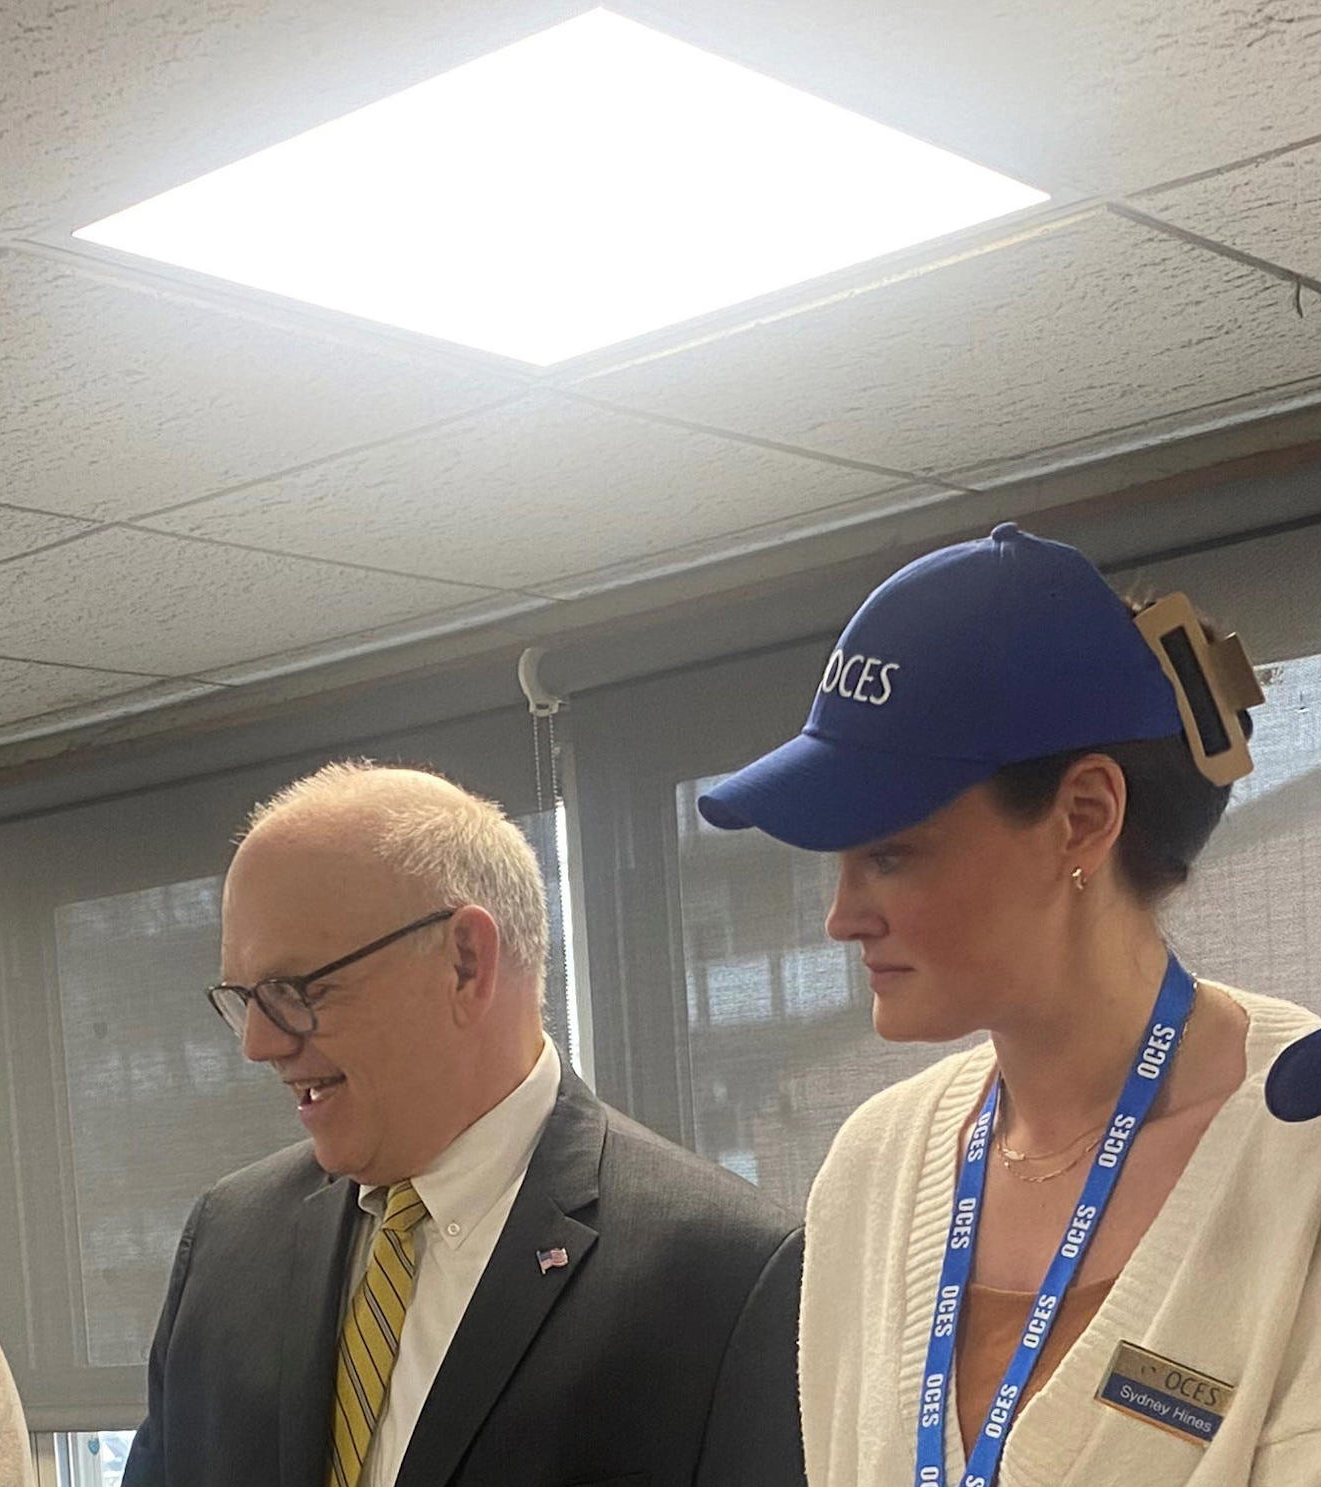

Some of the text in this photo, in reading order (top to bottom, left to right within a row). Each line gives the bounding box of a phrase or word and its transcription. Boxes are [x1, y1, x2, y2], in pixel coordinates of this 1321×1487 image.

[822, 649, 900, 705] OCES
[1137, 1024, 1176, 1080] OCES
[968, 1112, 991, 1163] OCES
[1098, 1113, 1136, 1168] OCES
[951, 1197, 976, 1250] OCES
[1061, 1204, 1096, 1259] OCES
[935, 1284, 960, 1338] OCES
[1023, 1294, 1057, 1349] OCES
[922, 1373, 944, 1428] OCES
[985, 1384, 1018, 1439] OCES
[1120, 1384, 1212, 1433] Sydney Hines
[1165, 1371, 1220, 1407] OCES
